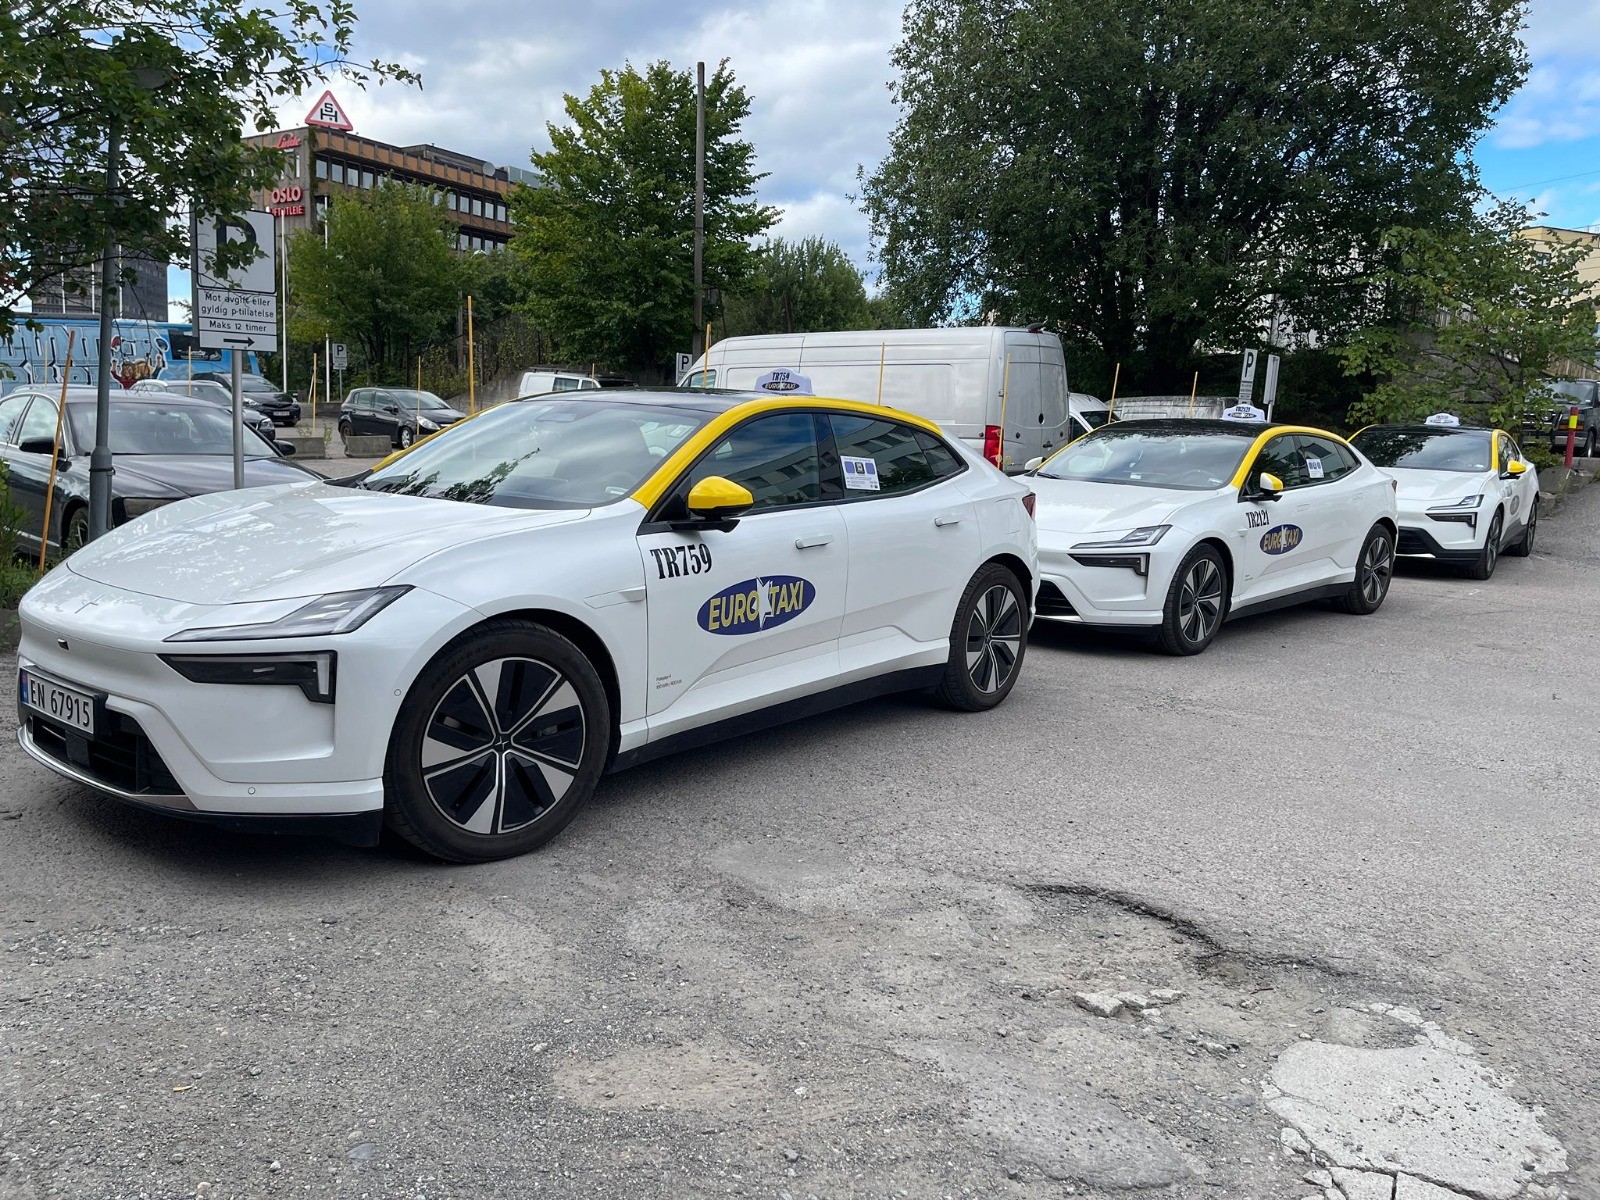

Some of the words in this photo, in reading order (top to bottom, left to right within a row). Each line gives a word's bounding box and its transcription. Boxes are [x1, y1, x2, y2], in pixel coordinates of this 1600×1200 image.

[271, 186, 302, 204] OSLO
[205, 293, 221, 302] Mot
[252, 297, 270, 306] eller
[201, 305, 228, 316] gyldig
[231, 307, 274, 318] p-tillatelse
[209, 320, 231, 330] Maks
[245, 323, 267, 332] timer
[336, 345, 344, 356] P
[681, 355, 690, 370] P
[1245, 352, 1254, 378] P
[772, 372, 790, 381] TR759
[1245, 510, 1270, 528] TR2121
[651, 543, 713, 580] TR759
[30, 679, 45, 709] EN
[50, 689, 90, 728] 67915
